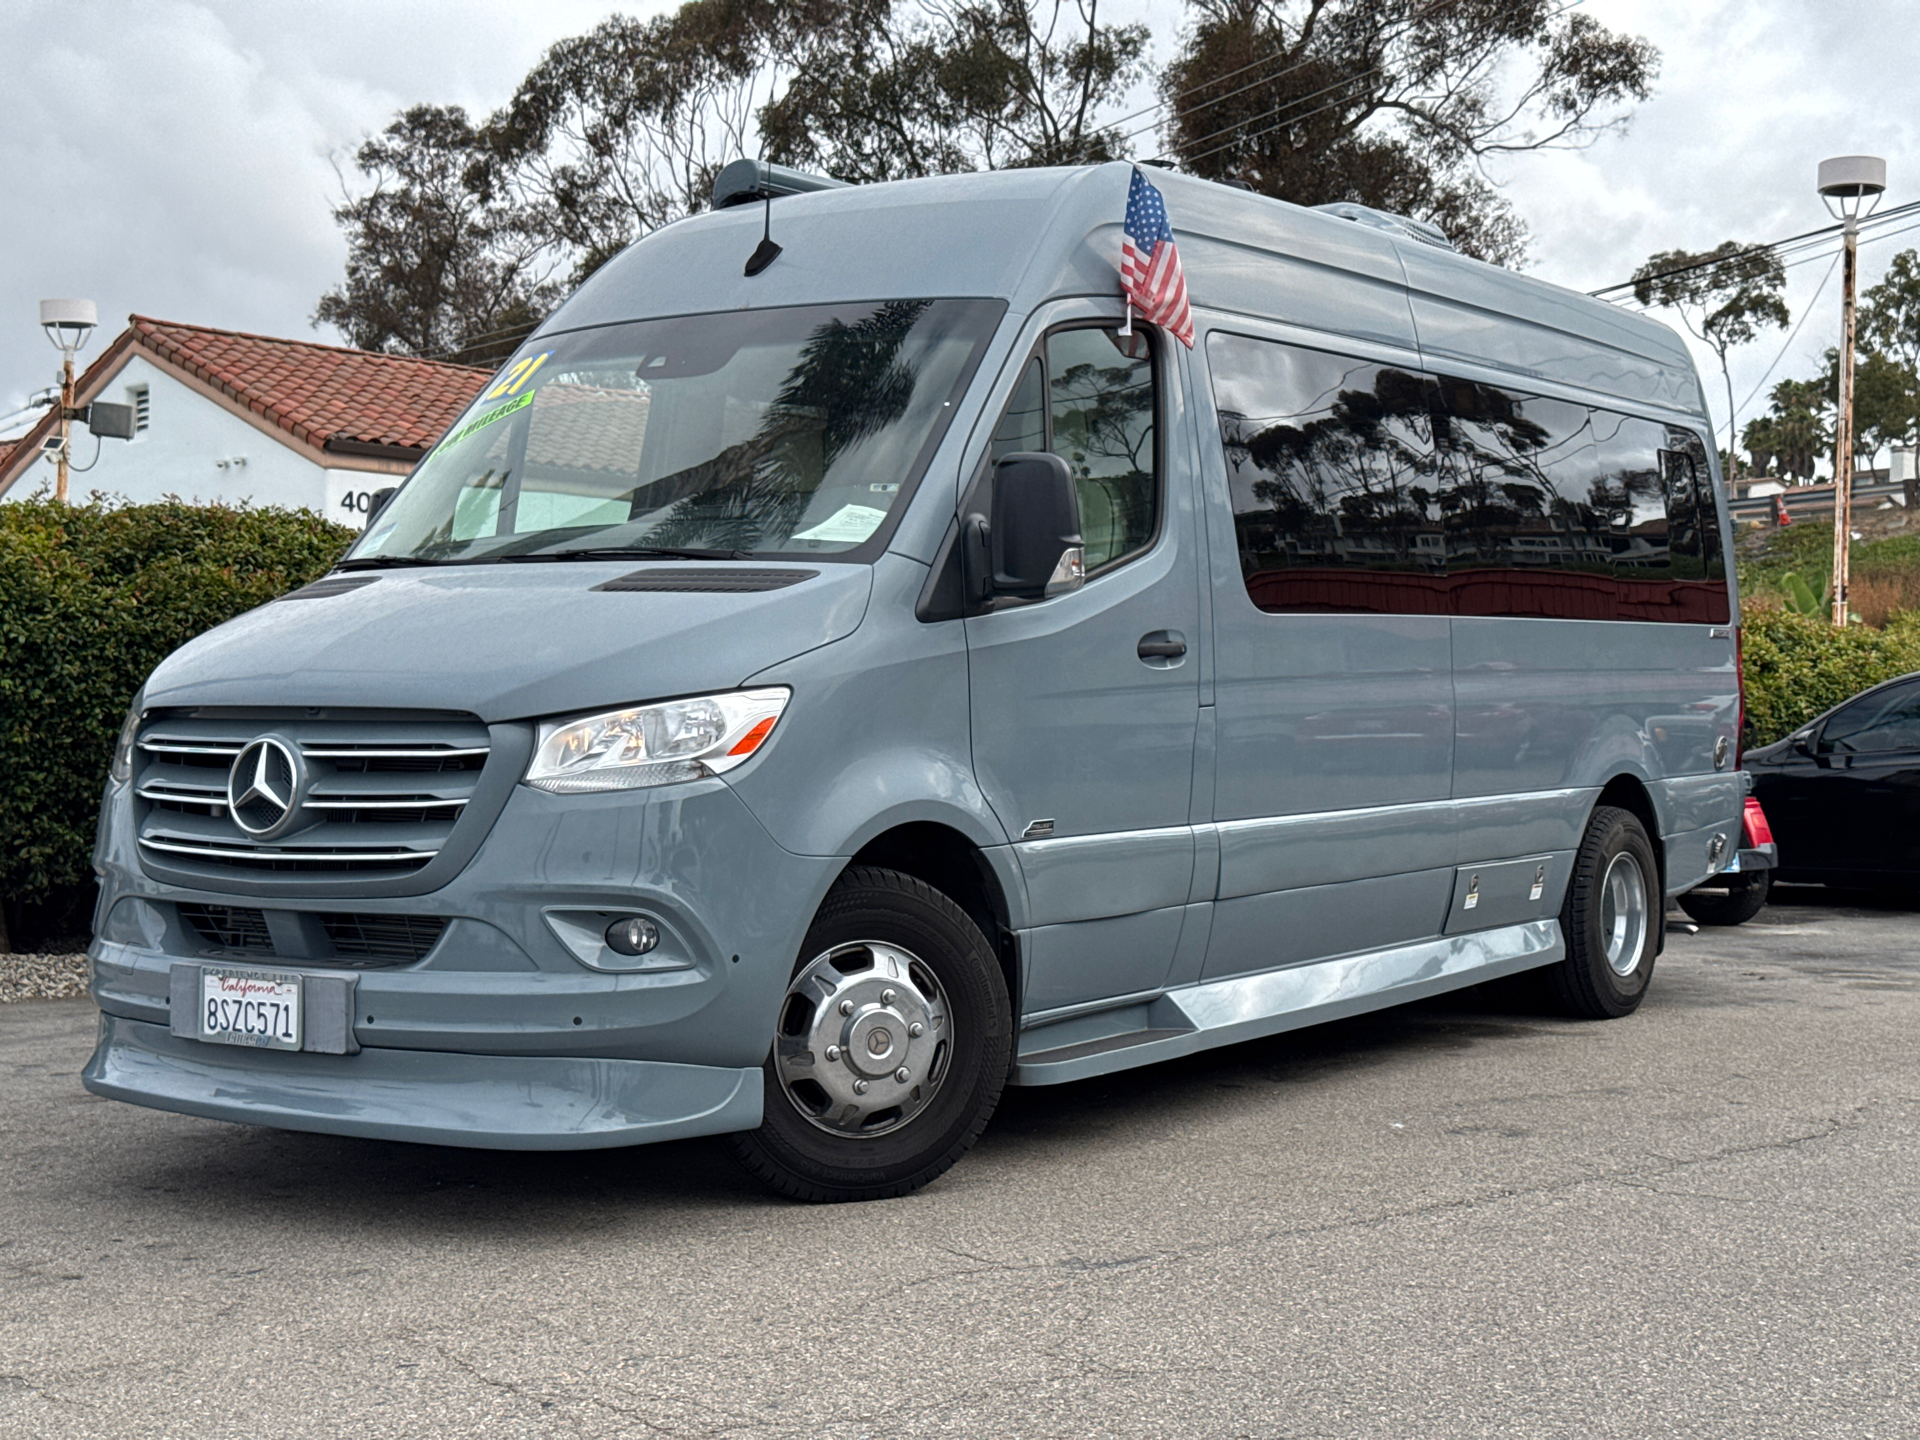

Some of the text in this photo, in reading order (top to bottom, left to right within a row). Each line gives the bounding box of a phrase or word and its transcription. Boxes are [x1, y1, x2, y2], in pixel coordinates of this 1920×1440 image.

[485, 353, 549, 400] 21
[463, 394, 528, 437] MILEAGE
[341, 490, 370, 513] 40
[203, 968, 298, 983] EXPERIENCE LIFE
[221, 977, 282, 997] California
[970, 958, 997, 1019] Continental
[207, 997, 293, 1038] 8SZC571
